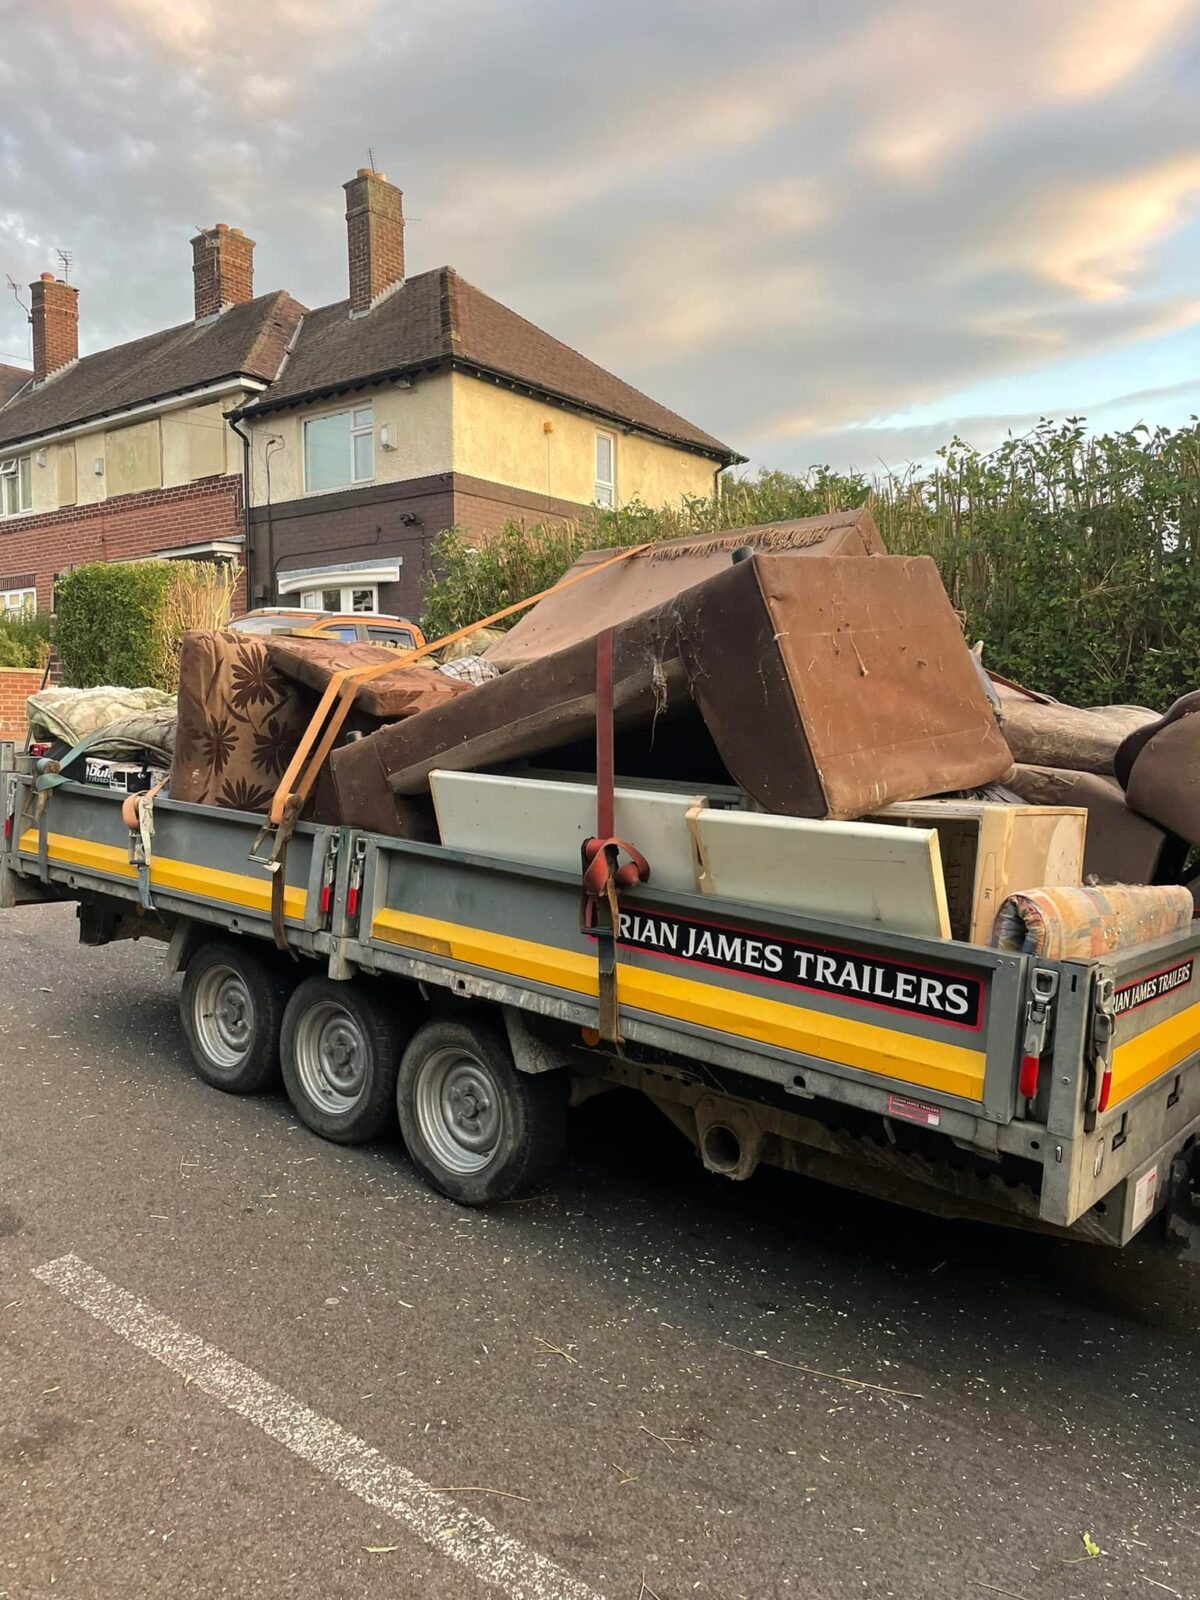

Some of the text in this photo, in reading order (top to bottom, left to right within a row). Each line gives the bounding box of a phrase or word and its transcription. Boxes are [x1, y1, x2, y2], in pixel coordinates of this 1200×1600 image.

[617, 913, 969, 1015] RIAN JAMES TRAILERS
[1114, 963, 1191, 1013] IAN JAMES TRAILERS
